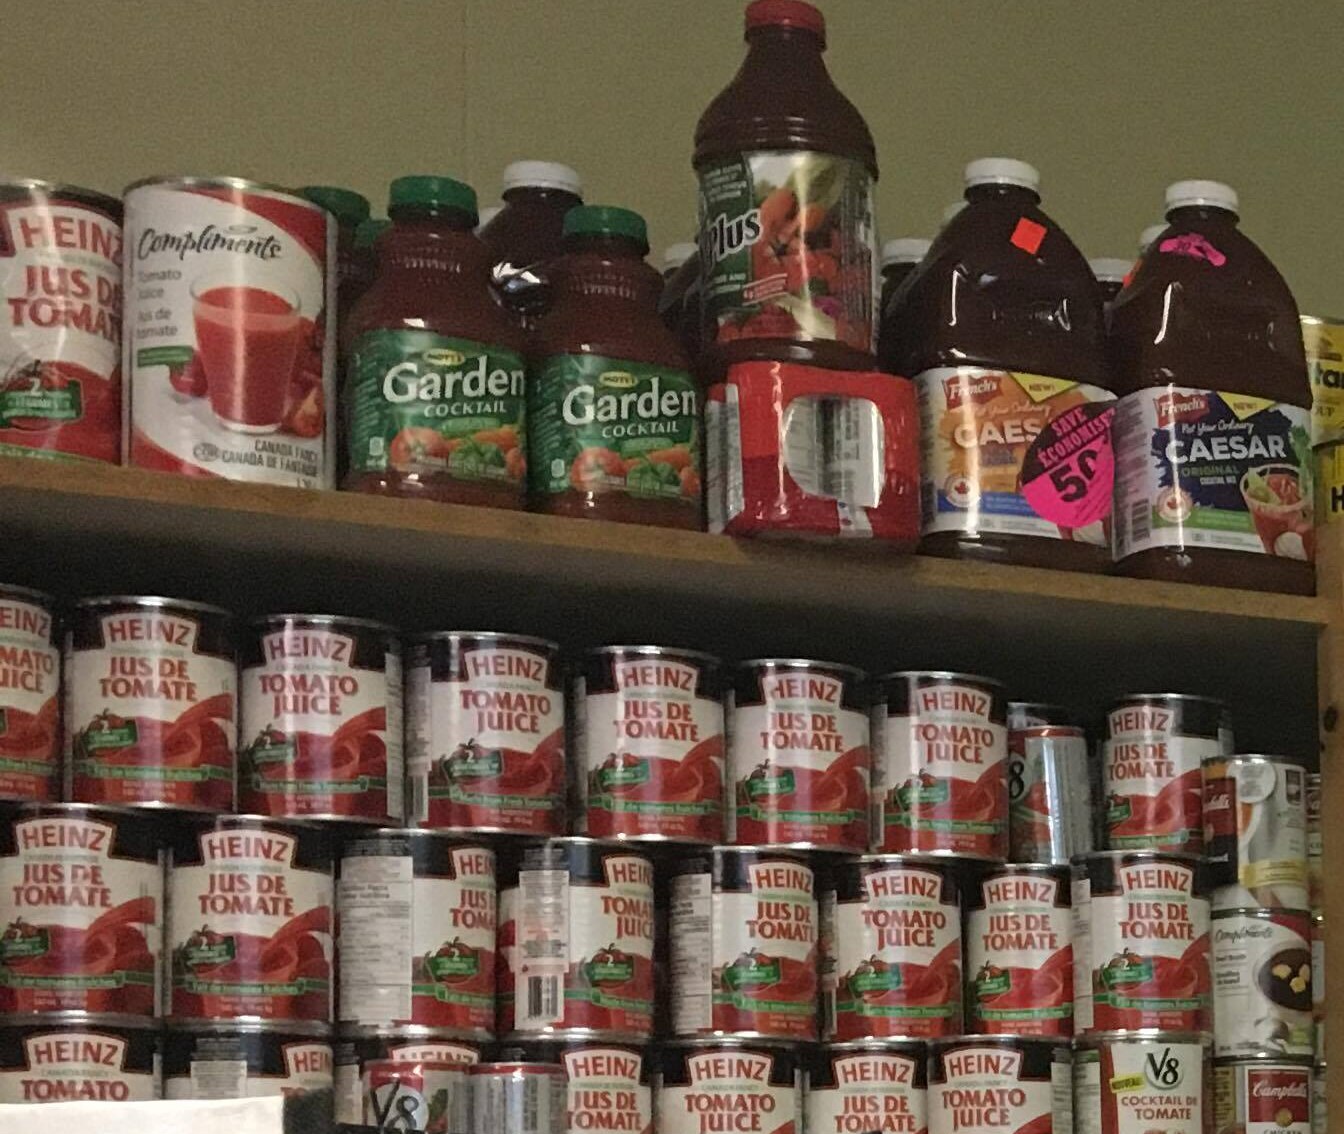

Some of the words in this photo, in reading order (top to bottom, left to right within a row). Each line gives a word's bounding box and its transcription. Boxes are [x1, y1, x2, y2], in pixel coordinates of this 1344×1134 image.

[137, 225, 282, 261] Compliments
[25, 265, 90, 298] JUS
[383, 355, 524, 403] Garden
[424, 401, 506, 418] COCKTAIL
[563, 377, 696, 426] Garden
[1160, 397, 1206, 417] French's
[602, 421, 679, 438] COCKTAIL
[954, 418, 1042, 448] CAES
[1051, 406, 1088, 437] SAVE
[1166, 435, 1287, 464] CAESAR
[1182, 465, 1240, 478] ORIGINAL
[108, 619, 191, 647] HEINZ
[269, 636, 347, 662] HEINZ
[109, 656, 153, 677] JUS
[159, 659, 188, 680] DE
[472, 655, 544, 681] HEINZ
[622, 666, 694, 691] HEINZ
[100, 677, 197, 701] TOMATE
[259, 674, 358, 697] TOMATO
[771, 676, 838, 703] HEINZ
[273, 694, 342, 717] JUICE
[460, 690, 551, 715] TOMATO
[624, 700, 662, 720] JUS
[666, 702, 692, 722] DE
[922, 693, 987, 717] HEINZ
[477, 711, 540, 734] JUICE
[613, 720, 699, 742] TOMATE
[770, 711, 807, 731] JUS
[811, 714, 837, 733] DE
[1111, 711, 1170, 736] HEINZ
[760, 731, 844, 753] TOMATE
[912, 724, 994, 748] TOMATO
[926, 742, 983, 764] JUICE
[1113, 743, 1140, 763] JUS
[1145, 742, 1169, 761] DE
[1108, 761, 1175, 781] TOMATE
[22, 822, 105, 853] HEINZ
[208, 835, 289, 863] HEINZ
[22, 864, 65, 885] JUS
[71, 865, 103, 885] DE
[209, 873, 250, 894] JUS
[257, 876, 287, 896] DE
[755, 872, 812, 894] HEINZ
[1126, 868, 1190, 892] HEINZ
[13, 886, 112, 909] TOMATE
[871, 876, 938, 899] HEINZ
[987, 880, 1053, 903] HEINZ
[199, 894, 295, 917] TOMATE
[757, 901, 788, 921] JUS
[1128, 902, 1160, 922] JUS
[1167, 903, 1189, 922] DE
[862, 909, 946, 930] TOMATO
[988, 913, 1020, 932] JUS
[1026, 914, 1051, 932] DE
[1119, 920, 1195, 940] TOMATE
[878, 927, 936, 948] JUICE
[982, 931, 1057, 951] TOMATE
[1214, 926, 1273, 943] Compliments
[34, 1040, 119, 1066] HEINZ
[573, 1055, 639, 1080] HEINZ
[695, 1058, 767, 1081] HEINZ
[842, 1062, 911, 1084] HEINZ
[949, 1055, 1015, 1076] HEINZ
[1147, 1047, 1180, 1086] V8
[21, 1079, 129, 1101] TOMATO
[575, 1091, 610, 1111] JUS
[615, 1094, 637, 1111] DE
[942, 1087, 1026, 1108] TOMATO
[684, 1094, 776, 1113] TOMATO
[843, 1095, 880, 1114] JUS
[884, 1096, 910, 1113] DE
[1121, 1095, 1182, 1109] COCKTAIL
[834, 1114, 916, 1133] TOMATE
[952, 1107, 1011, 1131] JUICE
[1134, 1107, 1192, 1122] TOMATE
